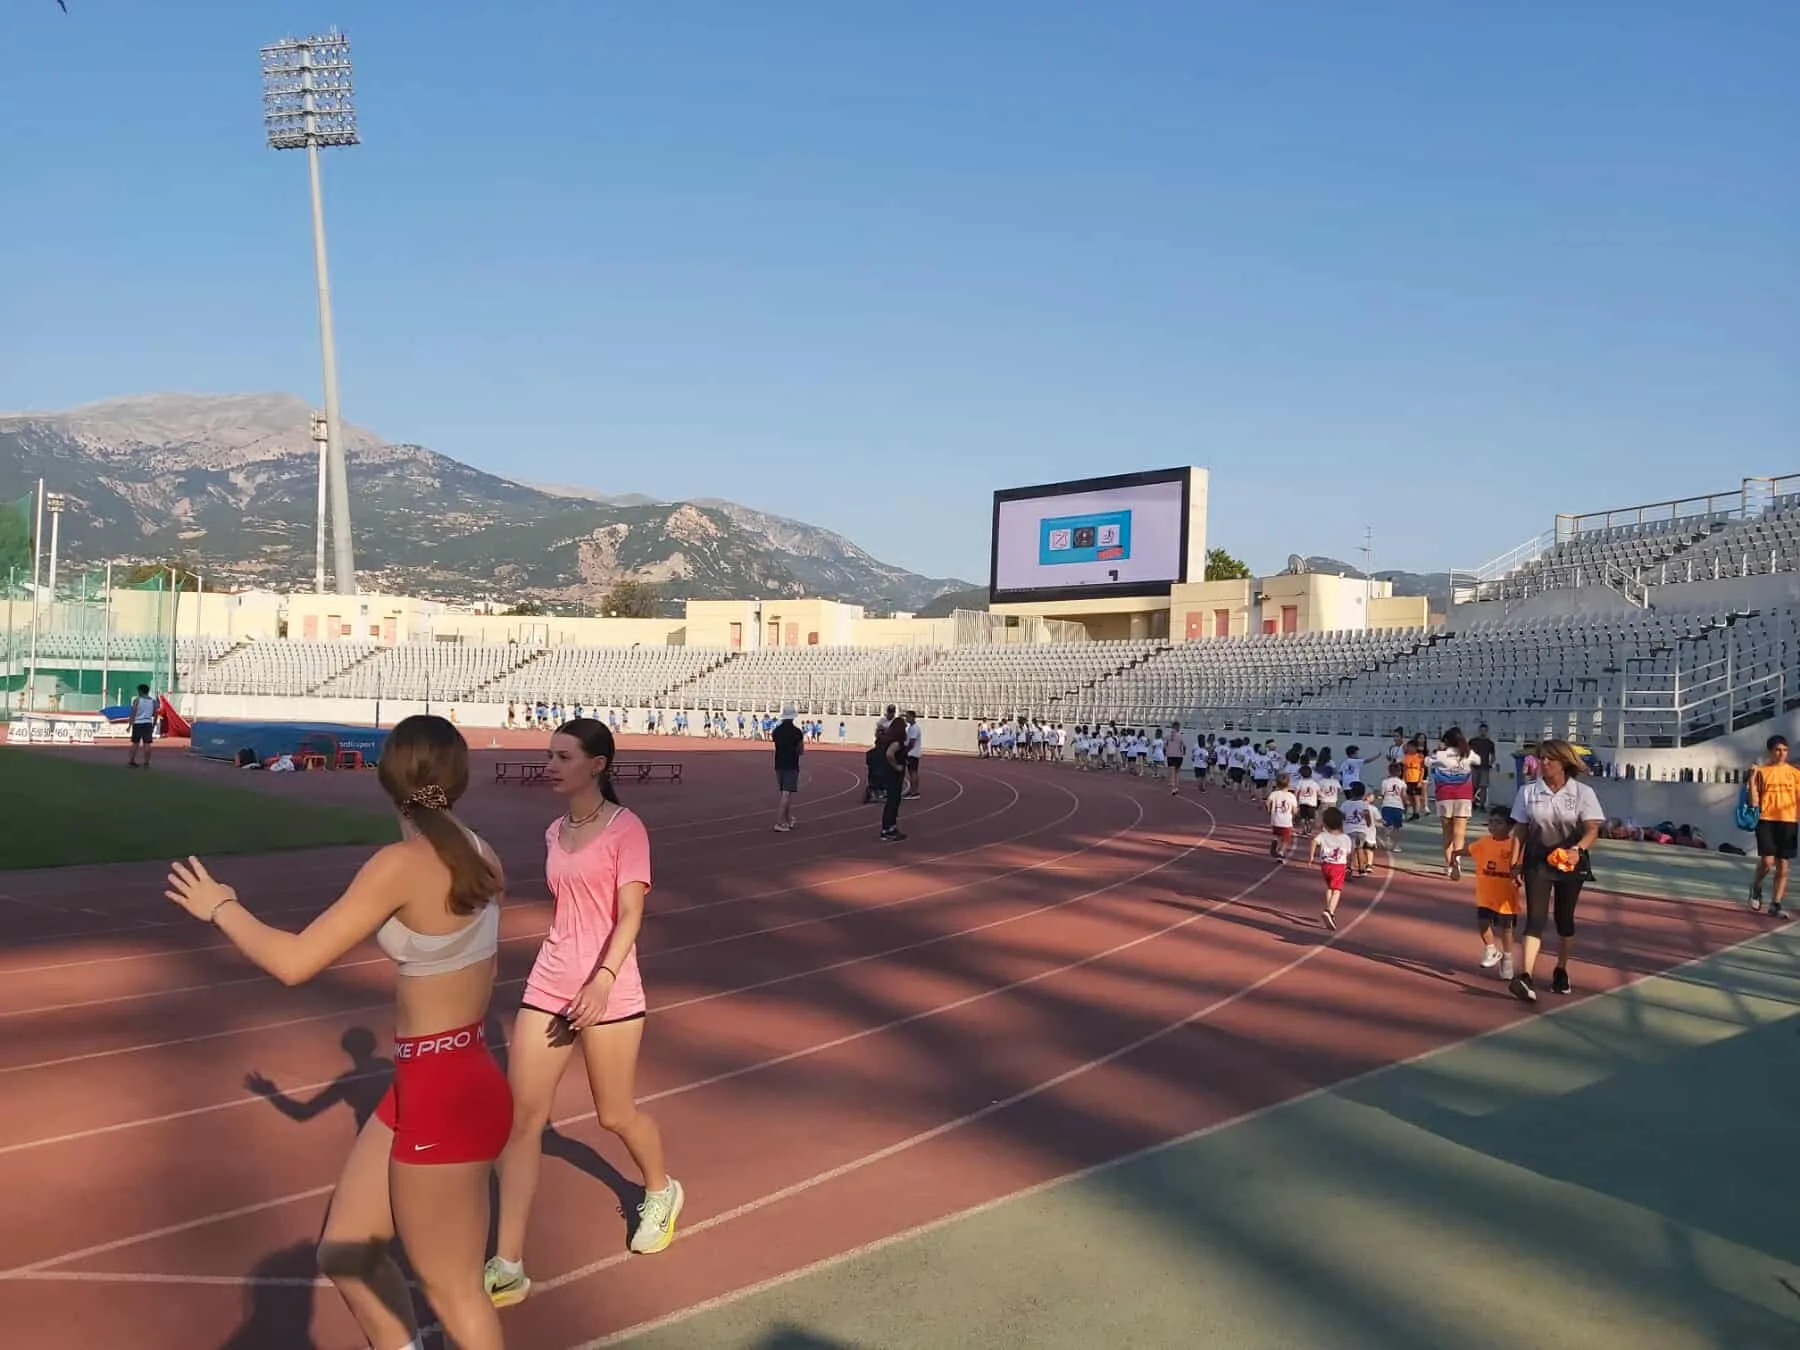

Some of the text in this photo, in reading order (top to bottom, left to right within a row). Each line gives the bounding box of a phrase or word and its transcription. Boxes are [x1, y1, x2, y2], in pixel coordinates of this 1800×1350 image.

[15, 727, 28, 738] 40
[57, 728, 69, 738] 60
[82, 728, 93, 738] 70
[416, 1031, 471, 1057] PRO
